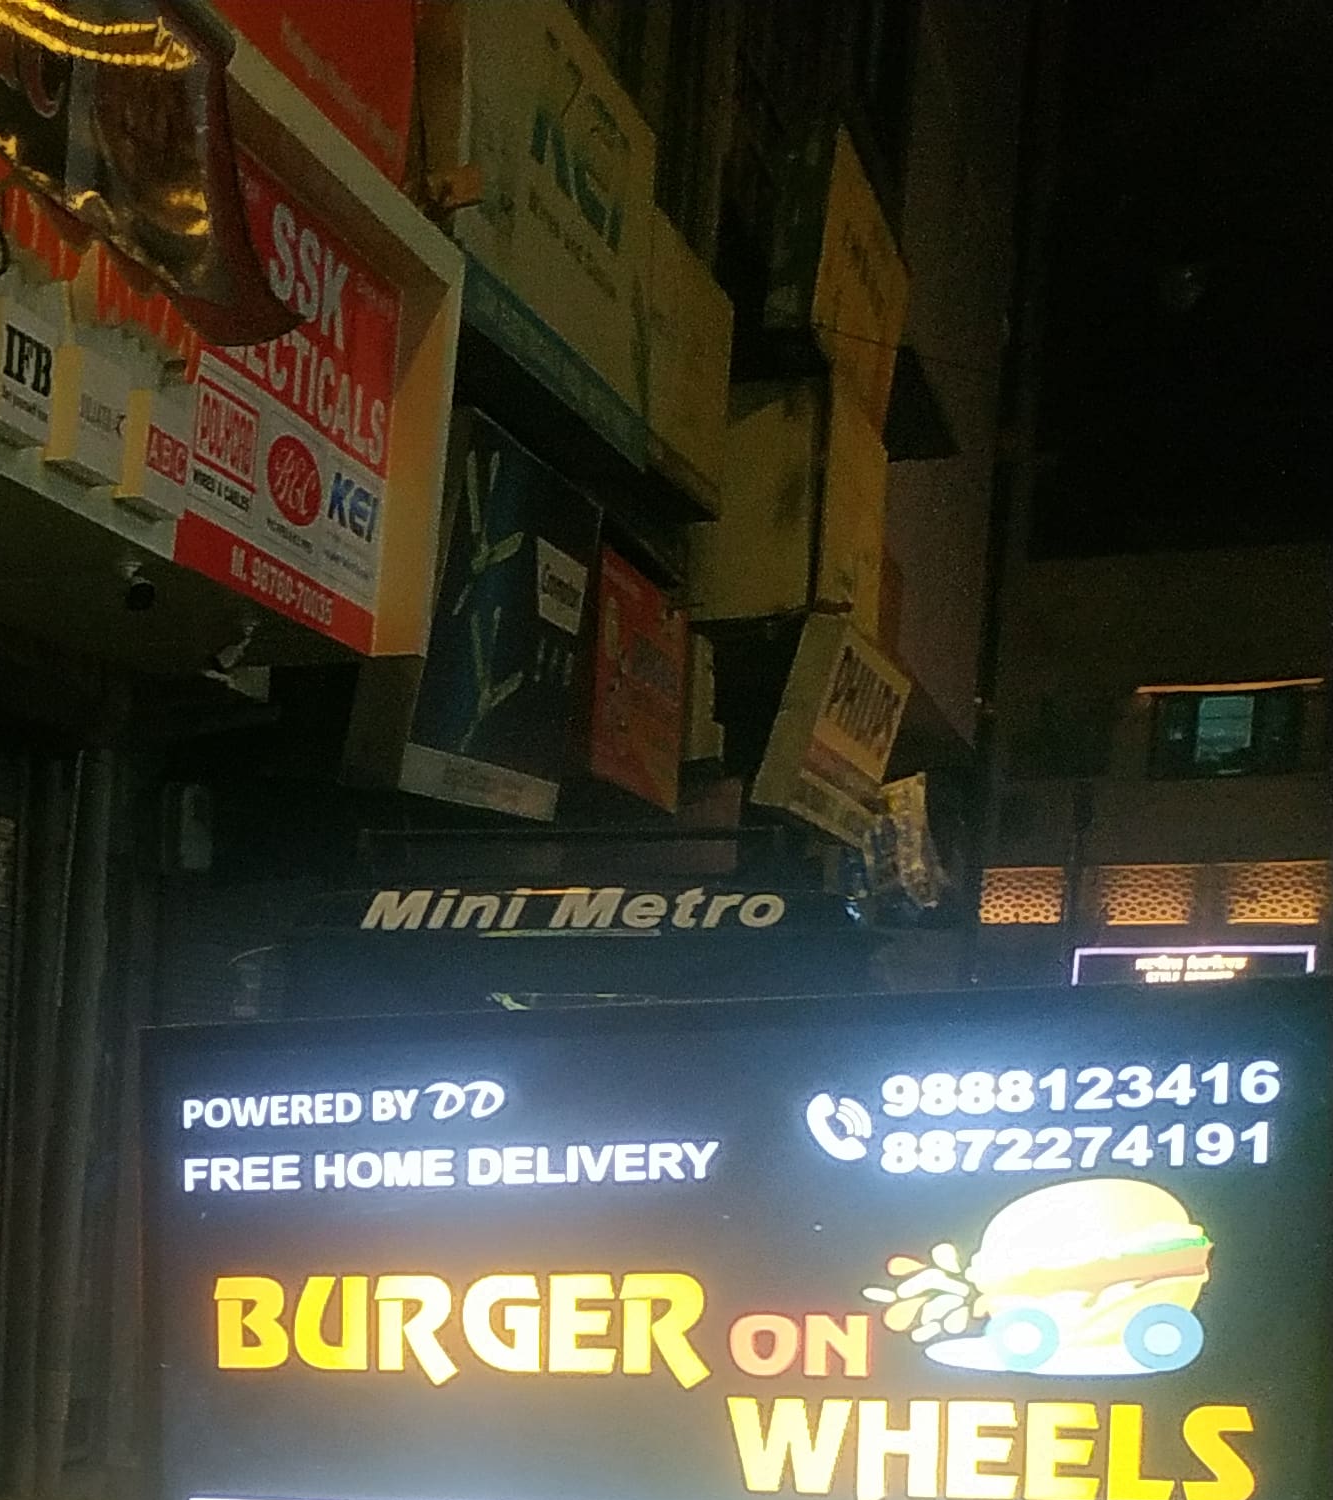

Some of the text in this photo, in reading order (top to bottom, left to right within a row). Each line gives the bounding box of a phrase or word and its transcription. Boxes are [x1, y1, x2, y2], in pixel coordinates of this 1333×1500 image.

[269, 203, 349, 351] SSK
[3, 324, 52, 397] IFB
[328, 472, 378, 543] KEI
[360, 886, 785, 931] Mini Metro
[182, 1091, 363, 1129] POWERED
[371, 1088, 419, 1123] BY
[880, 1060, 1282, 1118] 9888123416
[183, 1140, 720, 1191] FREE HOME DELIVERY
[880, 1121, 1270, 1174] 8872274191
[213, 1271, 872, 1390] BURGER ON
